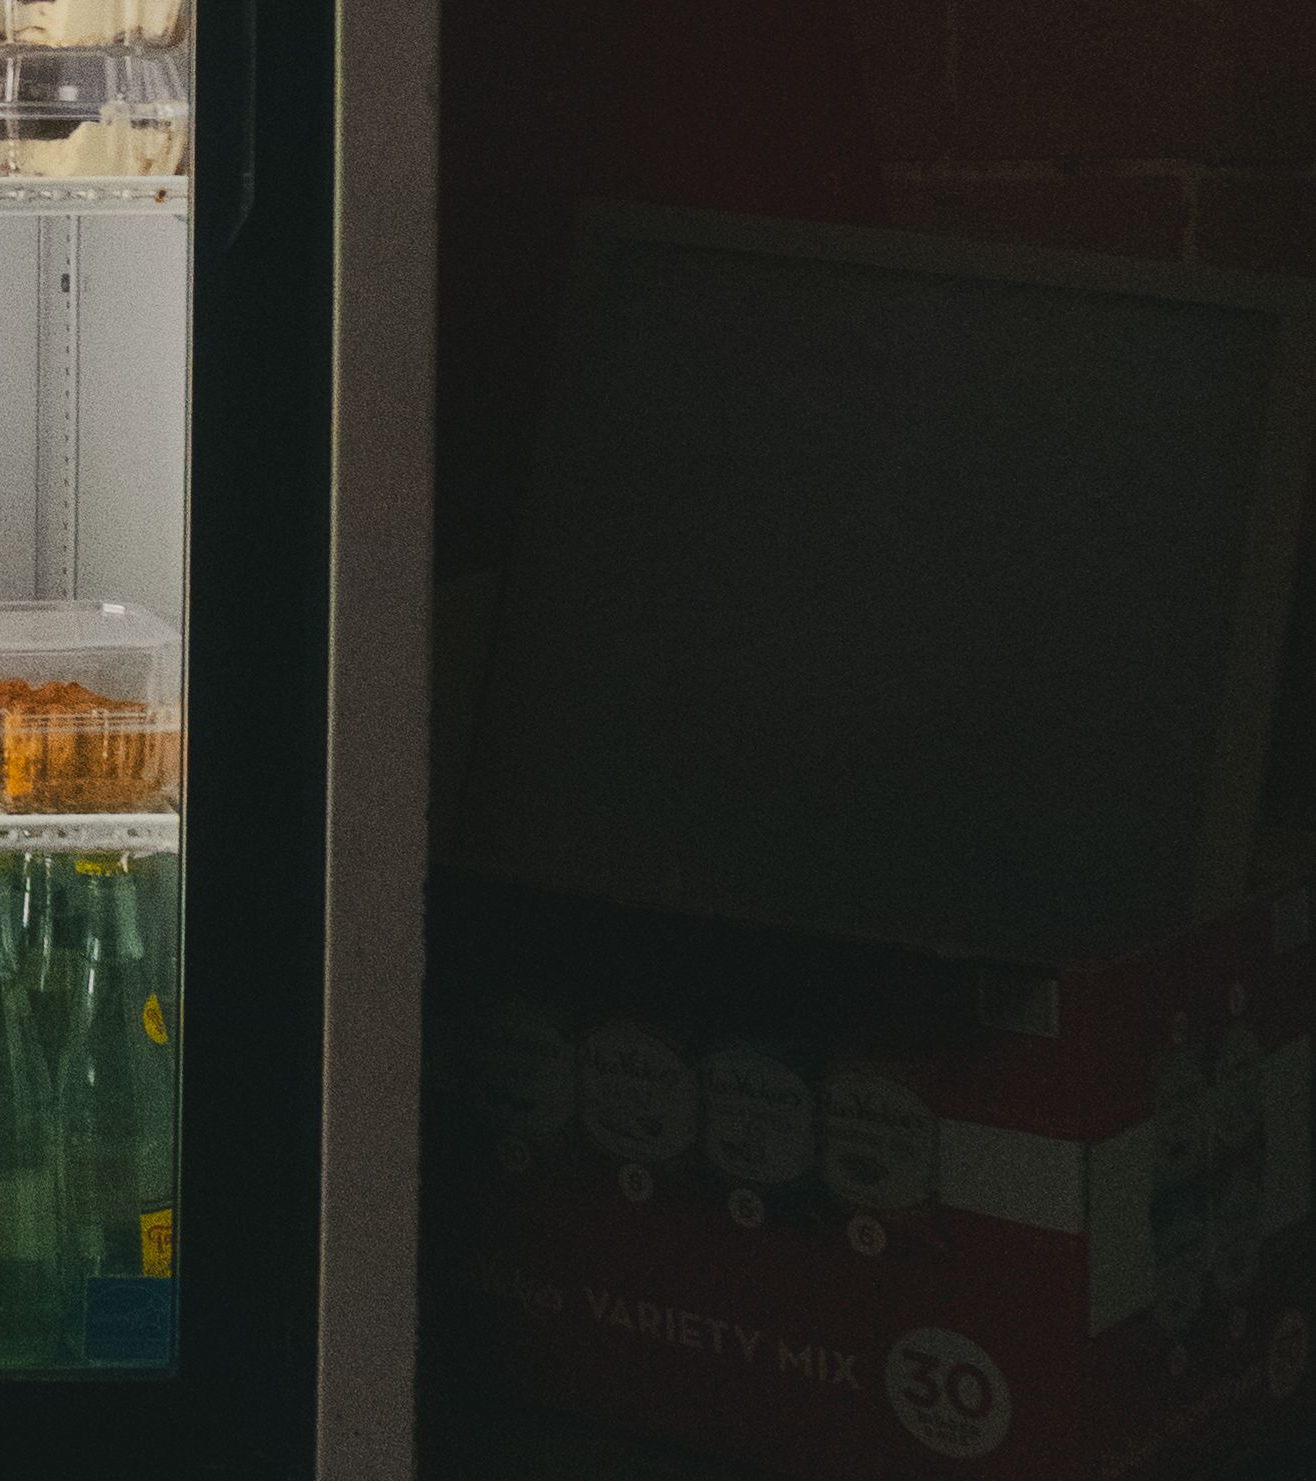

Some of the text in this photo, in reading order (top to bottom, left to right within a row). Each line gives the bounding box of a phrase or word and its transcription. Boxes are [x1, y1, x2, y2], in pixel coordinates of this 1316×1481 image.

[584, 1287, 863, 1391] VARIETY MIX
[902, 1347, 994, 1421] 30
